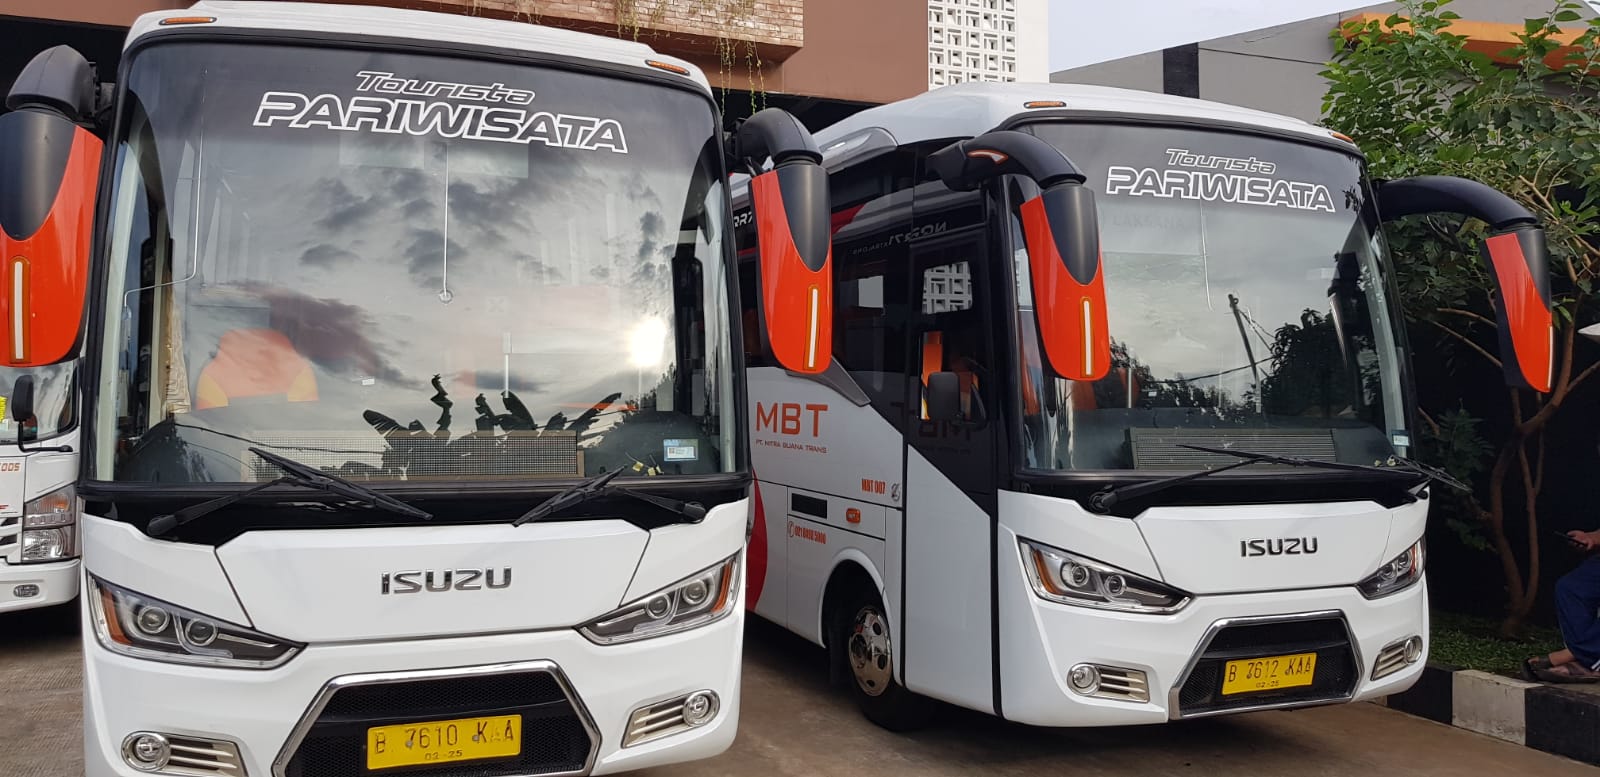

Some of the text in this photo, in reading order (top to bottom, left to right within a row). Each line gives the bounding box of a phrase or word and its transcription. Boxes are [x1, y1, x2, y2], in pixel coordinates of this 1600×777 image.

[356, 71, 535, 104] Tourista
[253, 91, 628, 153] PARIWISATA
[1166, 148, 1276, 175] Tourista
[1106, 165, 1336, 213] PARIWISATA
[756, 401, 828, 438] MBT
[0, 462, 21, 472] 005
[1240, 537, 1318, 557] ISUZU
[381, 566, 512, 595] ISUZU
[1228, 656, 1312, 682] B 7612 KAA
[375, 731, 386, 754] B
[405, 724, 458, 749] 7610
